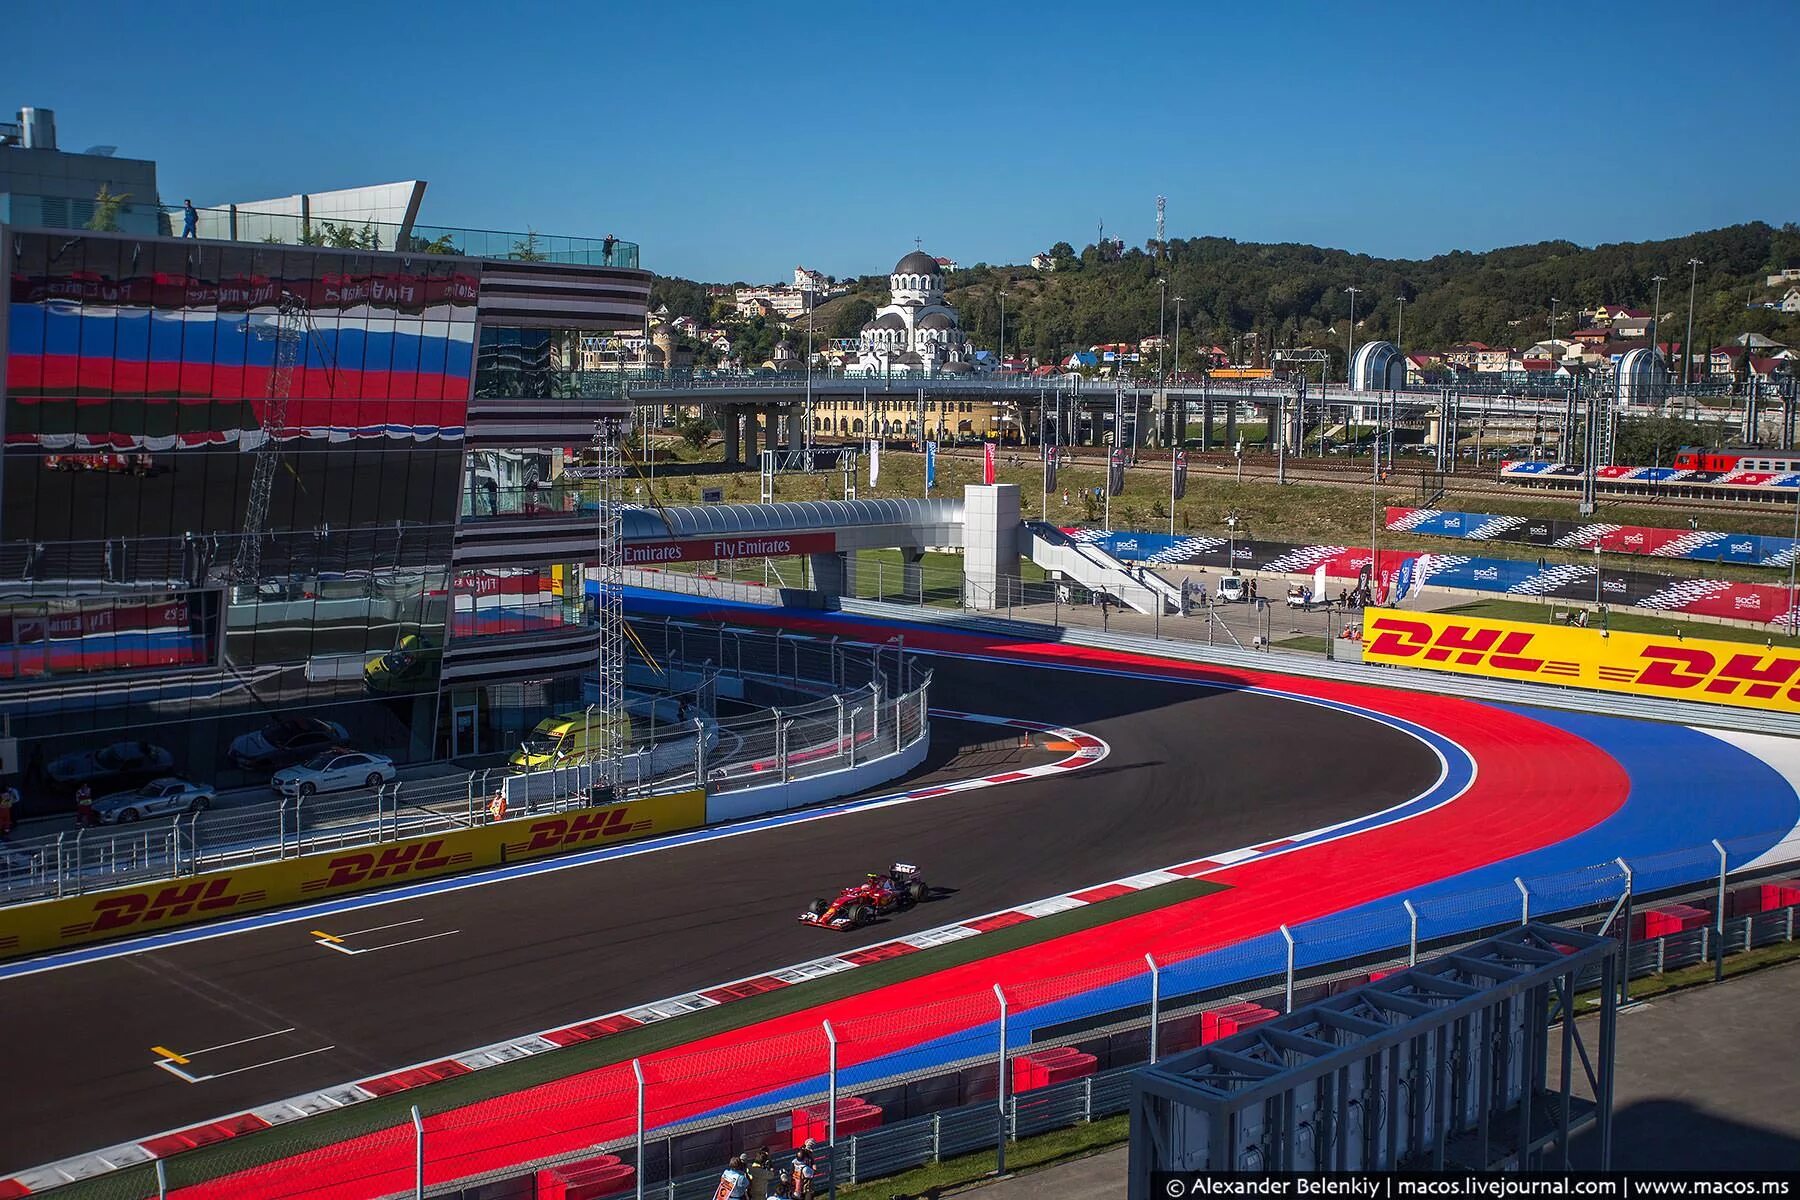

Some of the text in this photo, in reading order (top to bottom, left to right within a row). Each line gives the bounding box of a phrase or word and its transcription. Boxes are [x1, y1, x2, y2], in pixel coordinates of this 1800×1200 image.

[624, 540, 791, 562] Emirates Fly Emirates
[1116, 541, 1138, 549] SOCHI
[1730, 543, 1753, 551] SOCHI
[1473, 569, 1498, 577] SOCHI
[1602, 581, 1627, 590] SOCHI
[1734, 596, 1761, 606] SOCHI
[1368, 618, 1544, 673] DHL
[1636, 645, 1800, 703] DH
[528, 807, 636, 851] DHL
[327, 840, 453, 889] DHL
[92, 877, 239, 932] DHL
